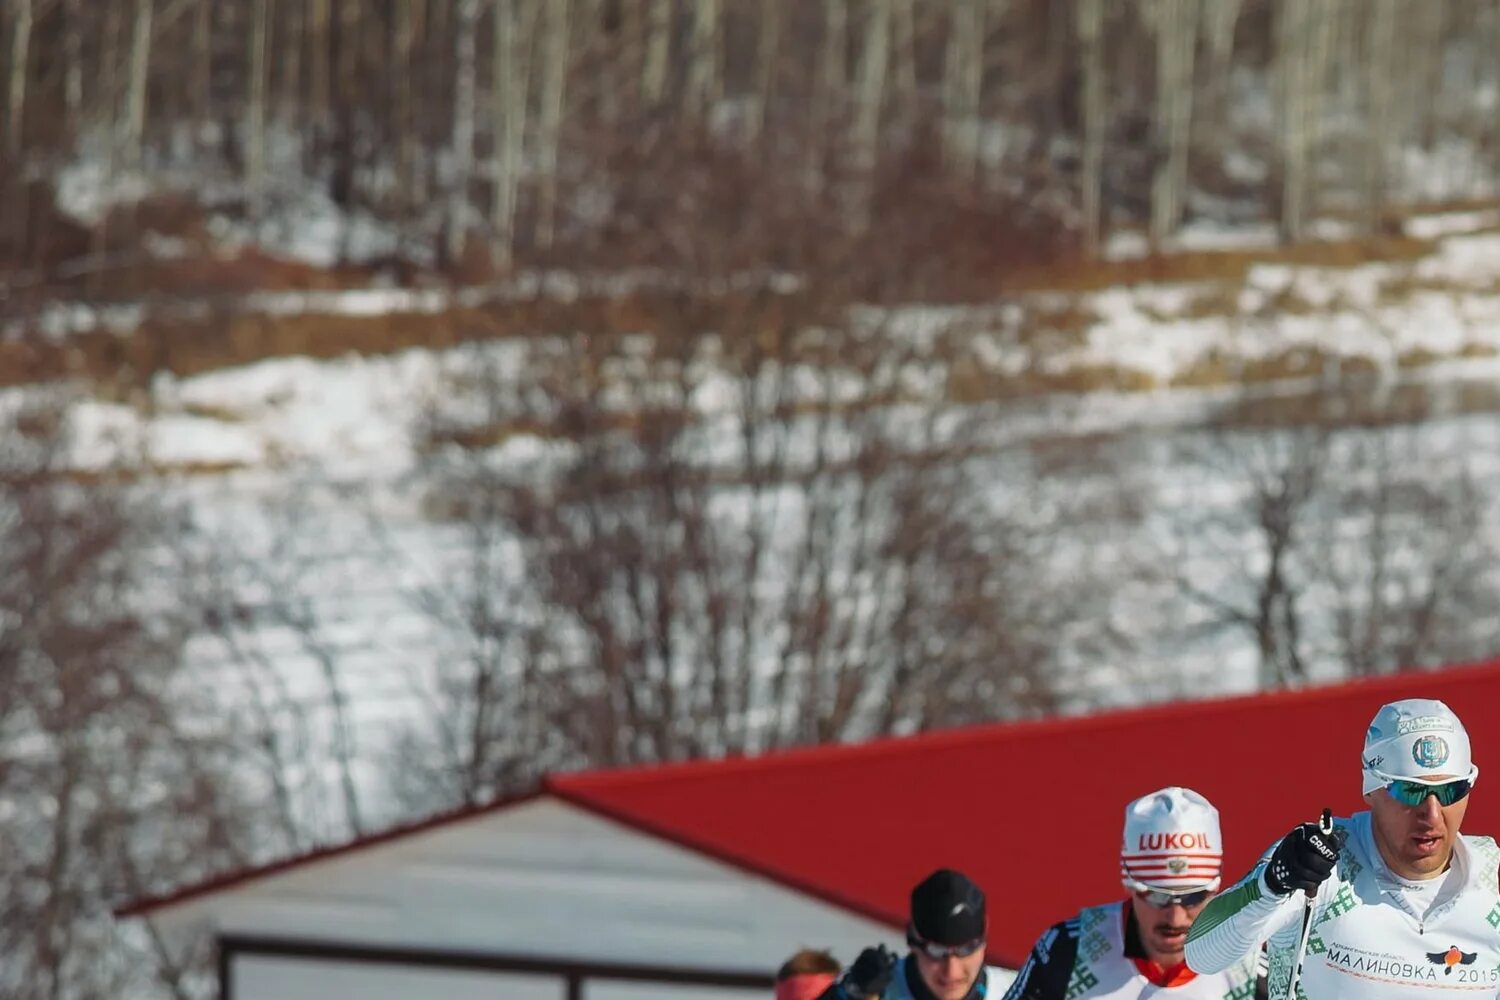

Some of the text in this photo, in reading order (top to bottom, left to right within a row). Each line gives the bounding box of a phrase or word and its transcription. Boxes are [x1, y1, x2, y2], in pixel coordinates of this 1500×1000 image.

[1139, 832, 1212, 851] LUKOIL
[1308, 834, 1334, 859] CRAFT
[1326, 948, 1499, 983] МАЛИНОВКА 2015
